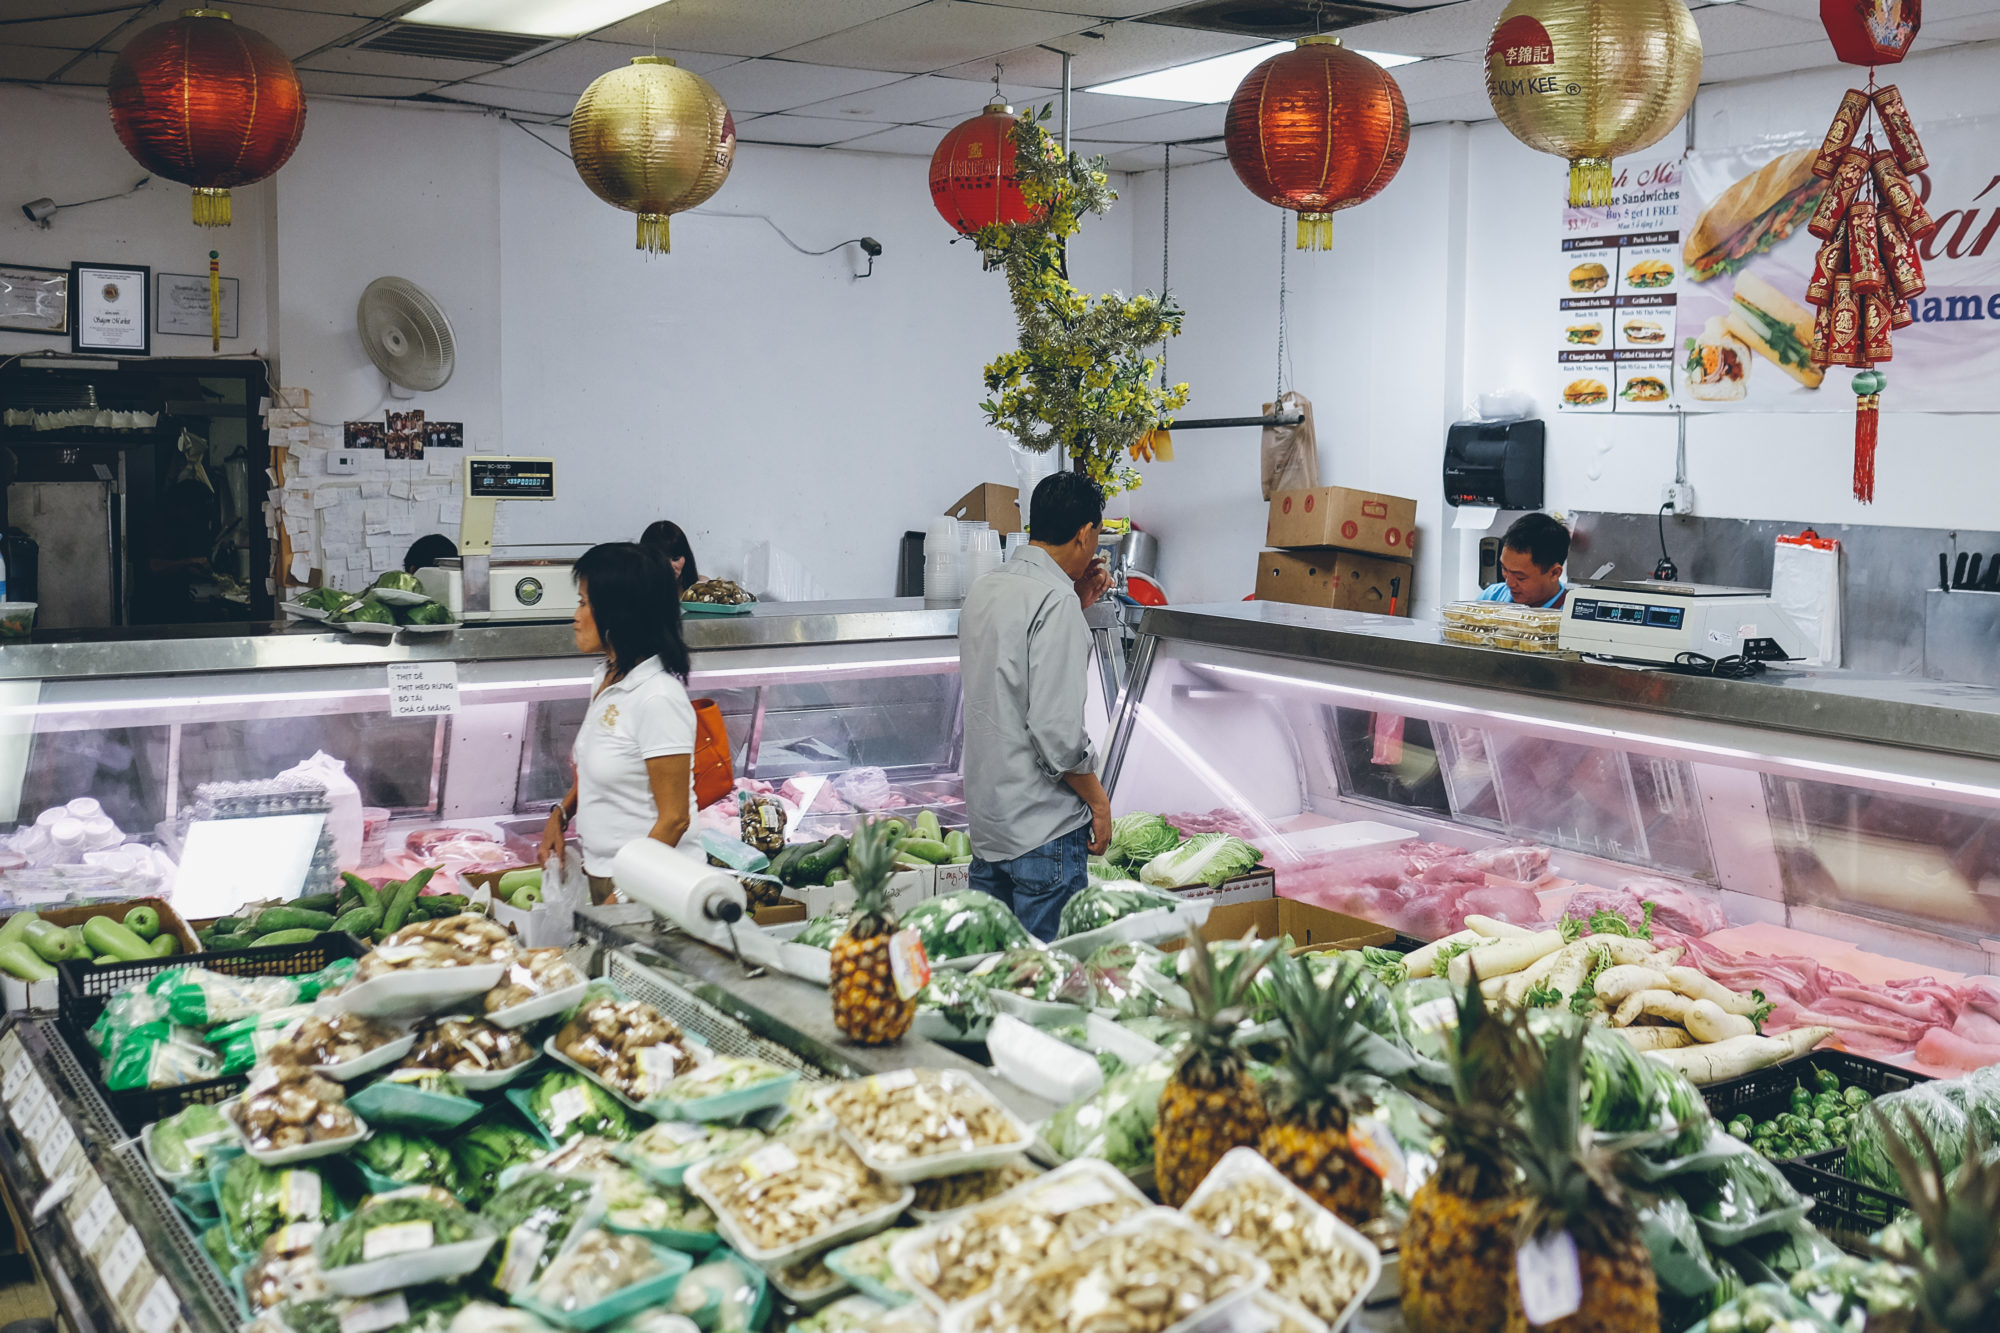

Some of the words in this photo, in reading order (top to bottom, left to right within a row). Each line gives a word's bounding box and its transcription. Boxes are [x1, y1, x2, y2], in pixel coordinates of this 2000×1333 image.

[1505, 46, 1550, 64] 李錦記
[1498, 79, 1525, 97] KUM
[1528, 77, 1559, 95] KEE
[1622, 188, 1680, 205] Sandwiches
[1606, 210, 1621, 220] Buy
[1631, 208, 1643, 219] get
[1653, 205, 1680, 216] FREE
